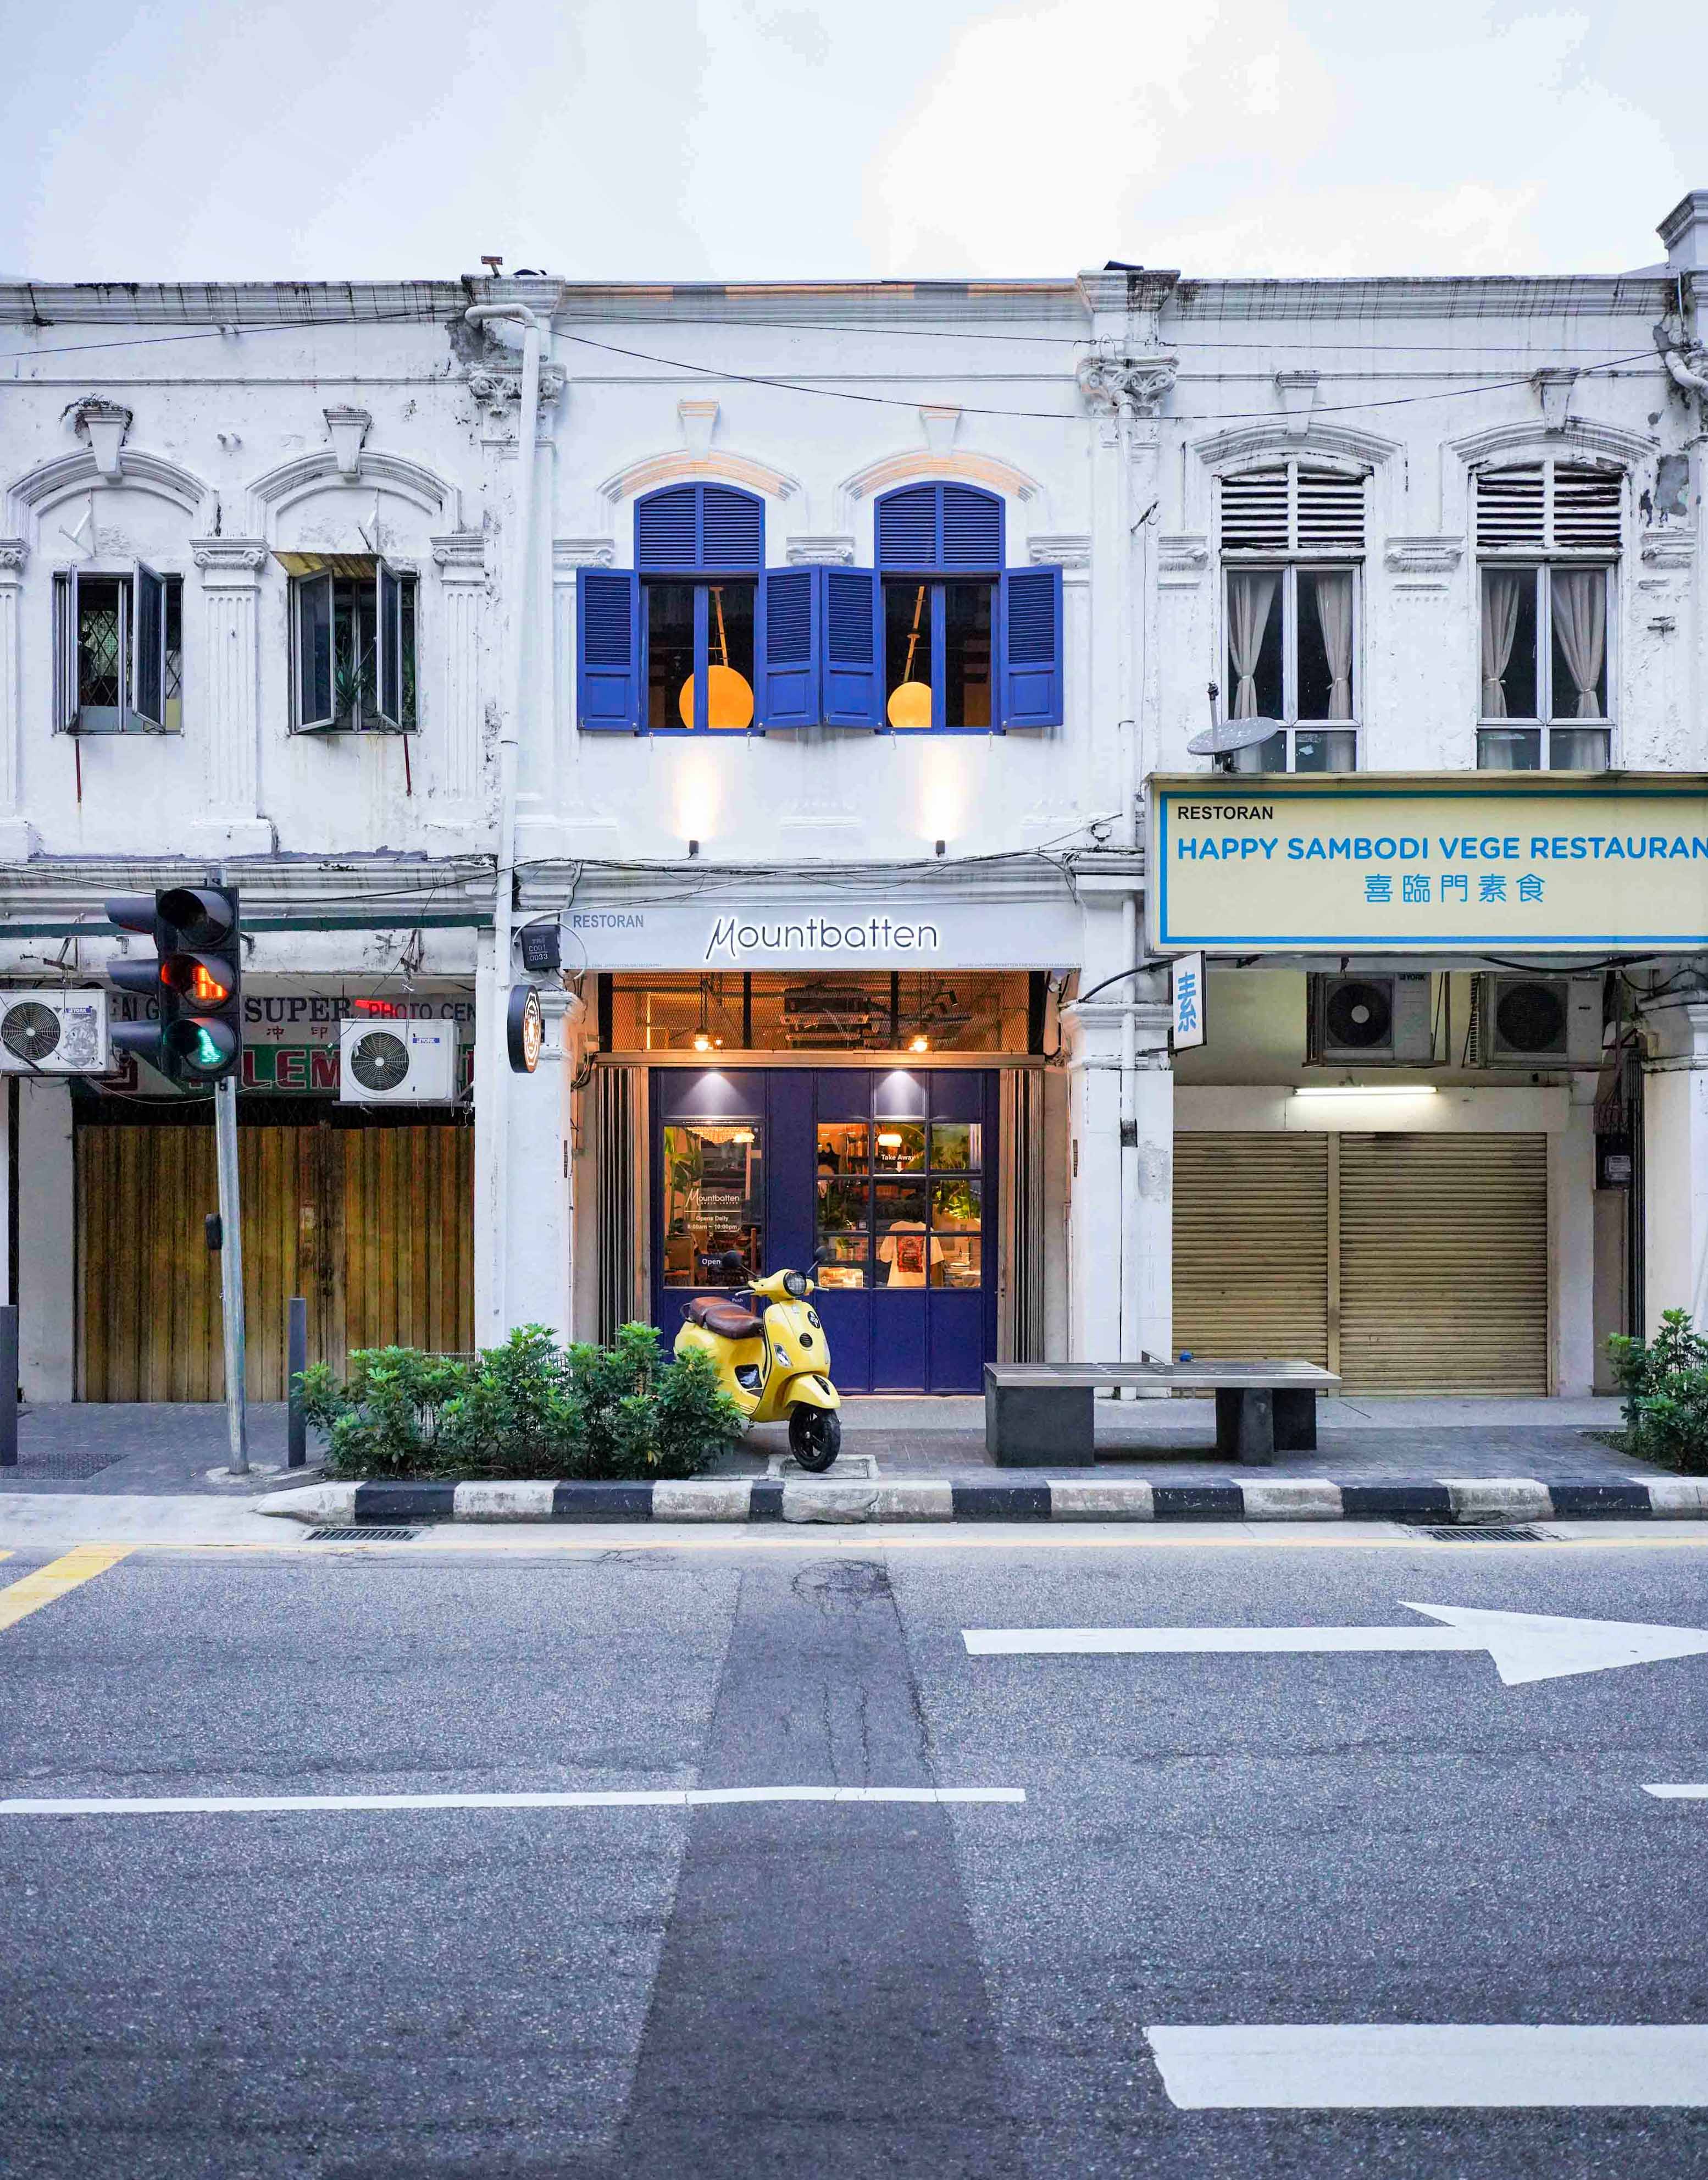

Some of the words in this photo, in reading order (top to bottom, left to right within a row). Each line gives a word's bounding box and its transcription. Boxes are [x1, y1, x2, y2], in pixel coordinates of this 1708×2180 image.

[1178, 806, 1274, 820] RESTORAN
[1178, 837, 1279, 860] HAPPY
[1286, 837, 1428, 860] SAMBODI
[1438, 837, 1520, 859] VEGE
[1530, 836, 1708, 859] RESTAURAN
[1363, 873, 1545, 903] 喜臨門素食
[573, 914, 644, 928] RESTORAN
[705, 918, 938, 960] Mountbatten
[245, 997, 353, 1022] SUPER
[369, 1003, 433, 1019] PHOTO
[1178, 970, 1197, 1033] 素
[685, 1188, 740, 1207] Mountbatten
[701, 1258, 721, 1266] Open
